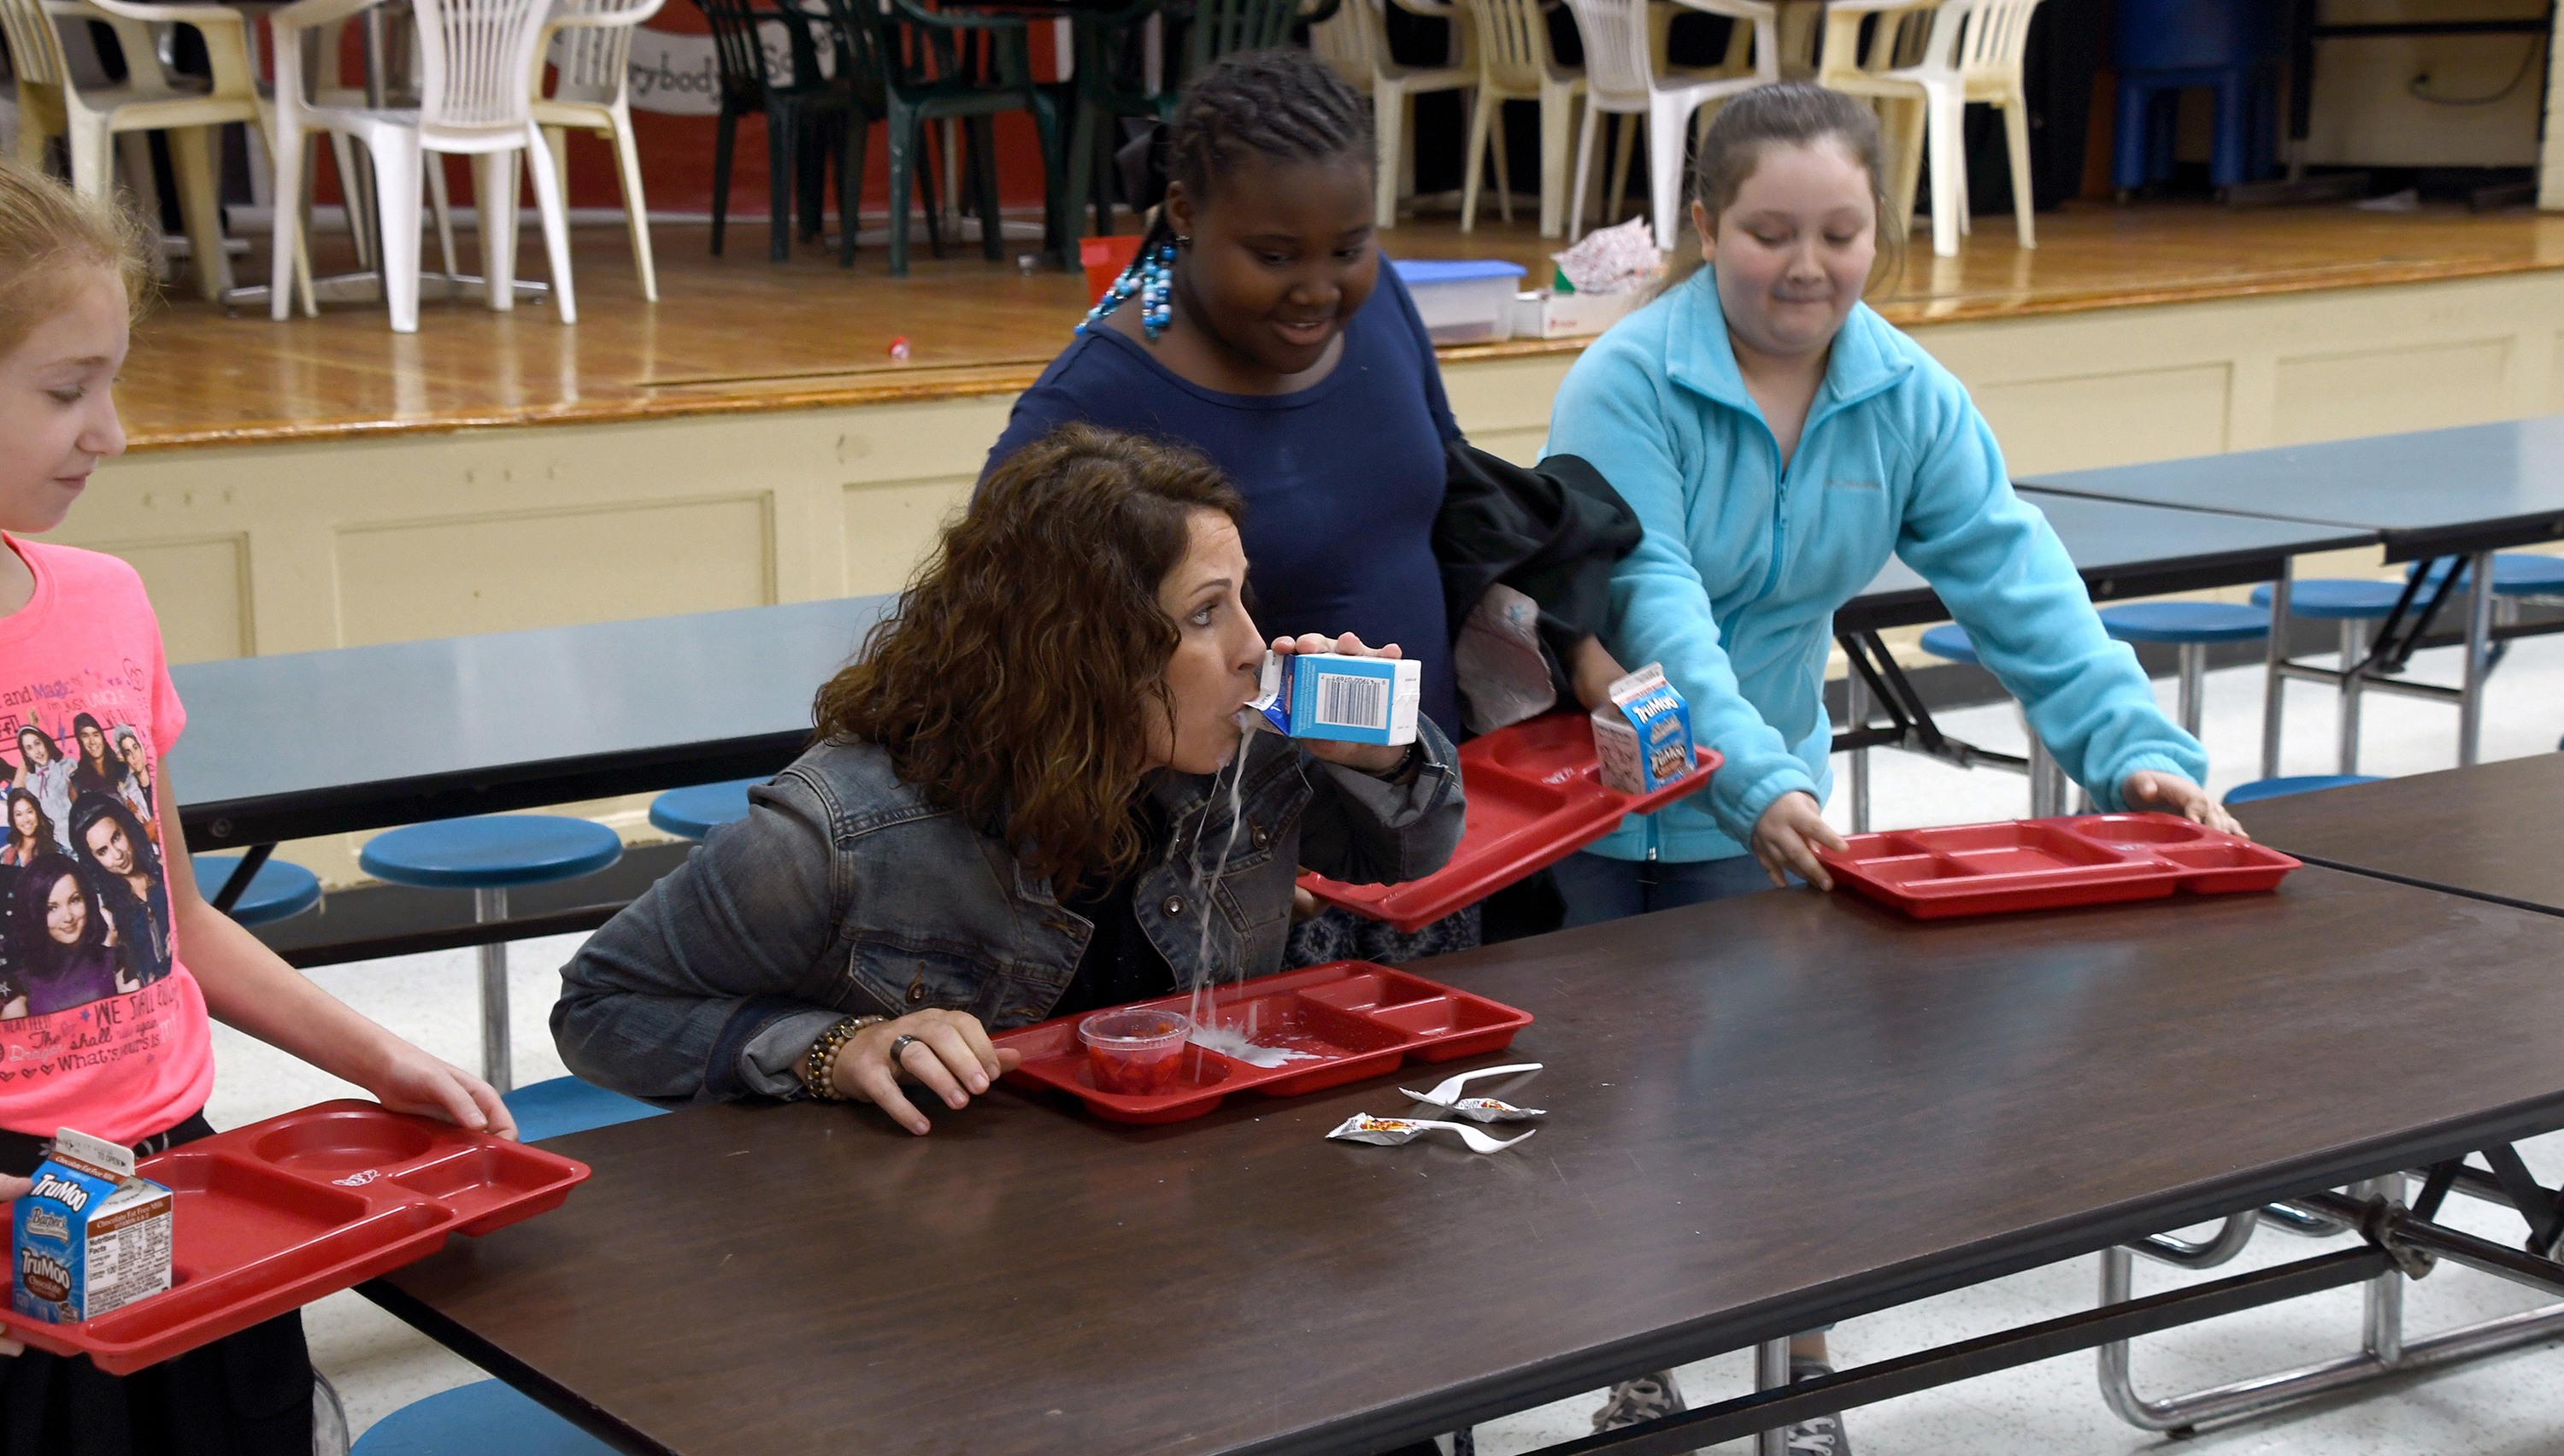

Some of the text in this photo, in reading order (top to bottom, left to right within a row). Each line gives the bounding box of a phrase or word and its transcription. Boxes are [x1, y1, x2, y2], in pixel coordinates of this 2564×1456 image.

[3, 687, 32, 707] and
[94, 999, 122, 1028] WE
[28, 1030, 62, 1049] The
[70, 1026, 113, 1051] shall
[106, 1154, 121, 1165] OPEN
[30, 1173, 89, 1212] TruMoo
[97, 1213, 127, 1229] Chocolate
[22, 1249, 70, 1289] TruMoo
